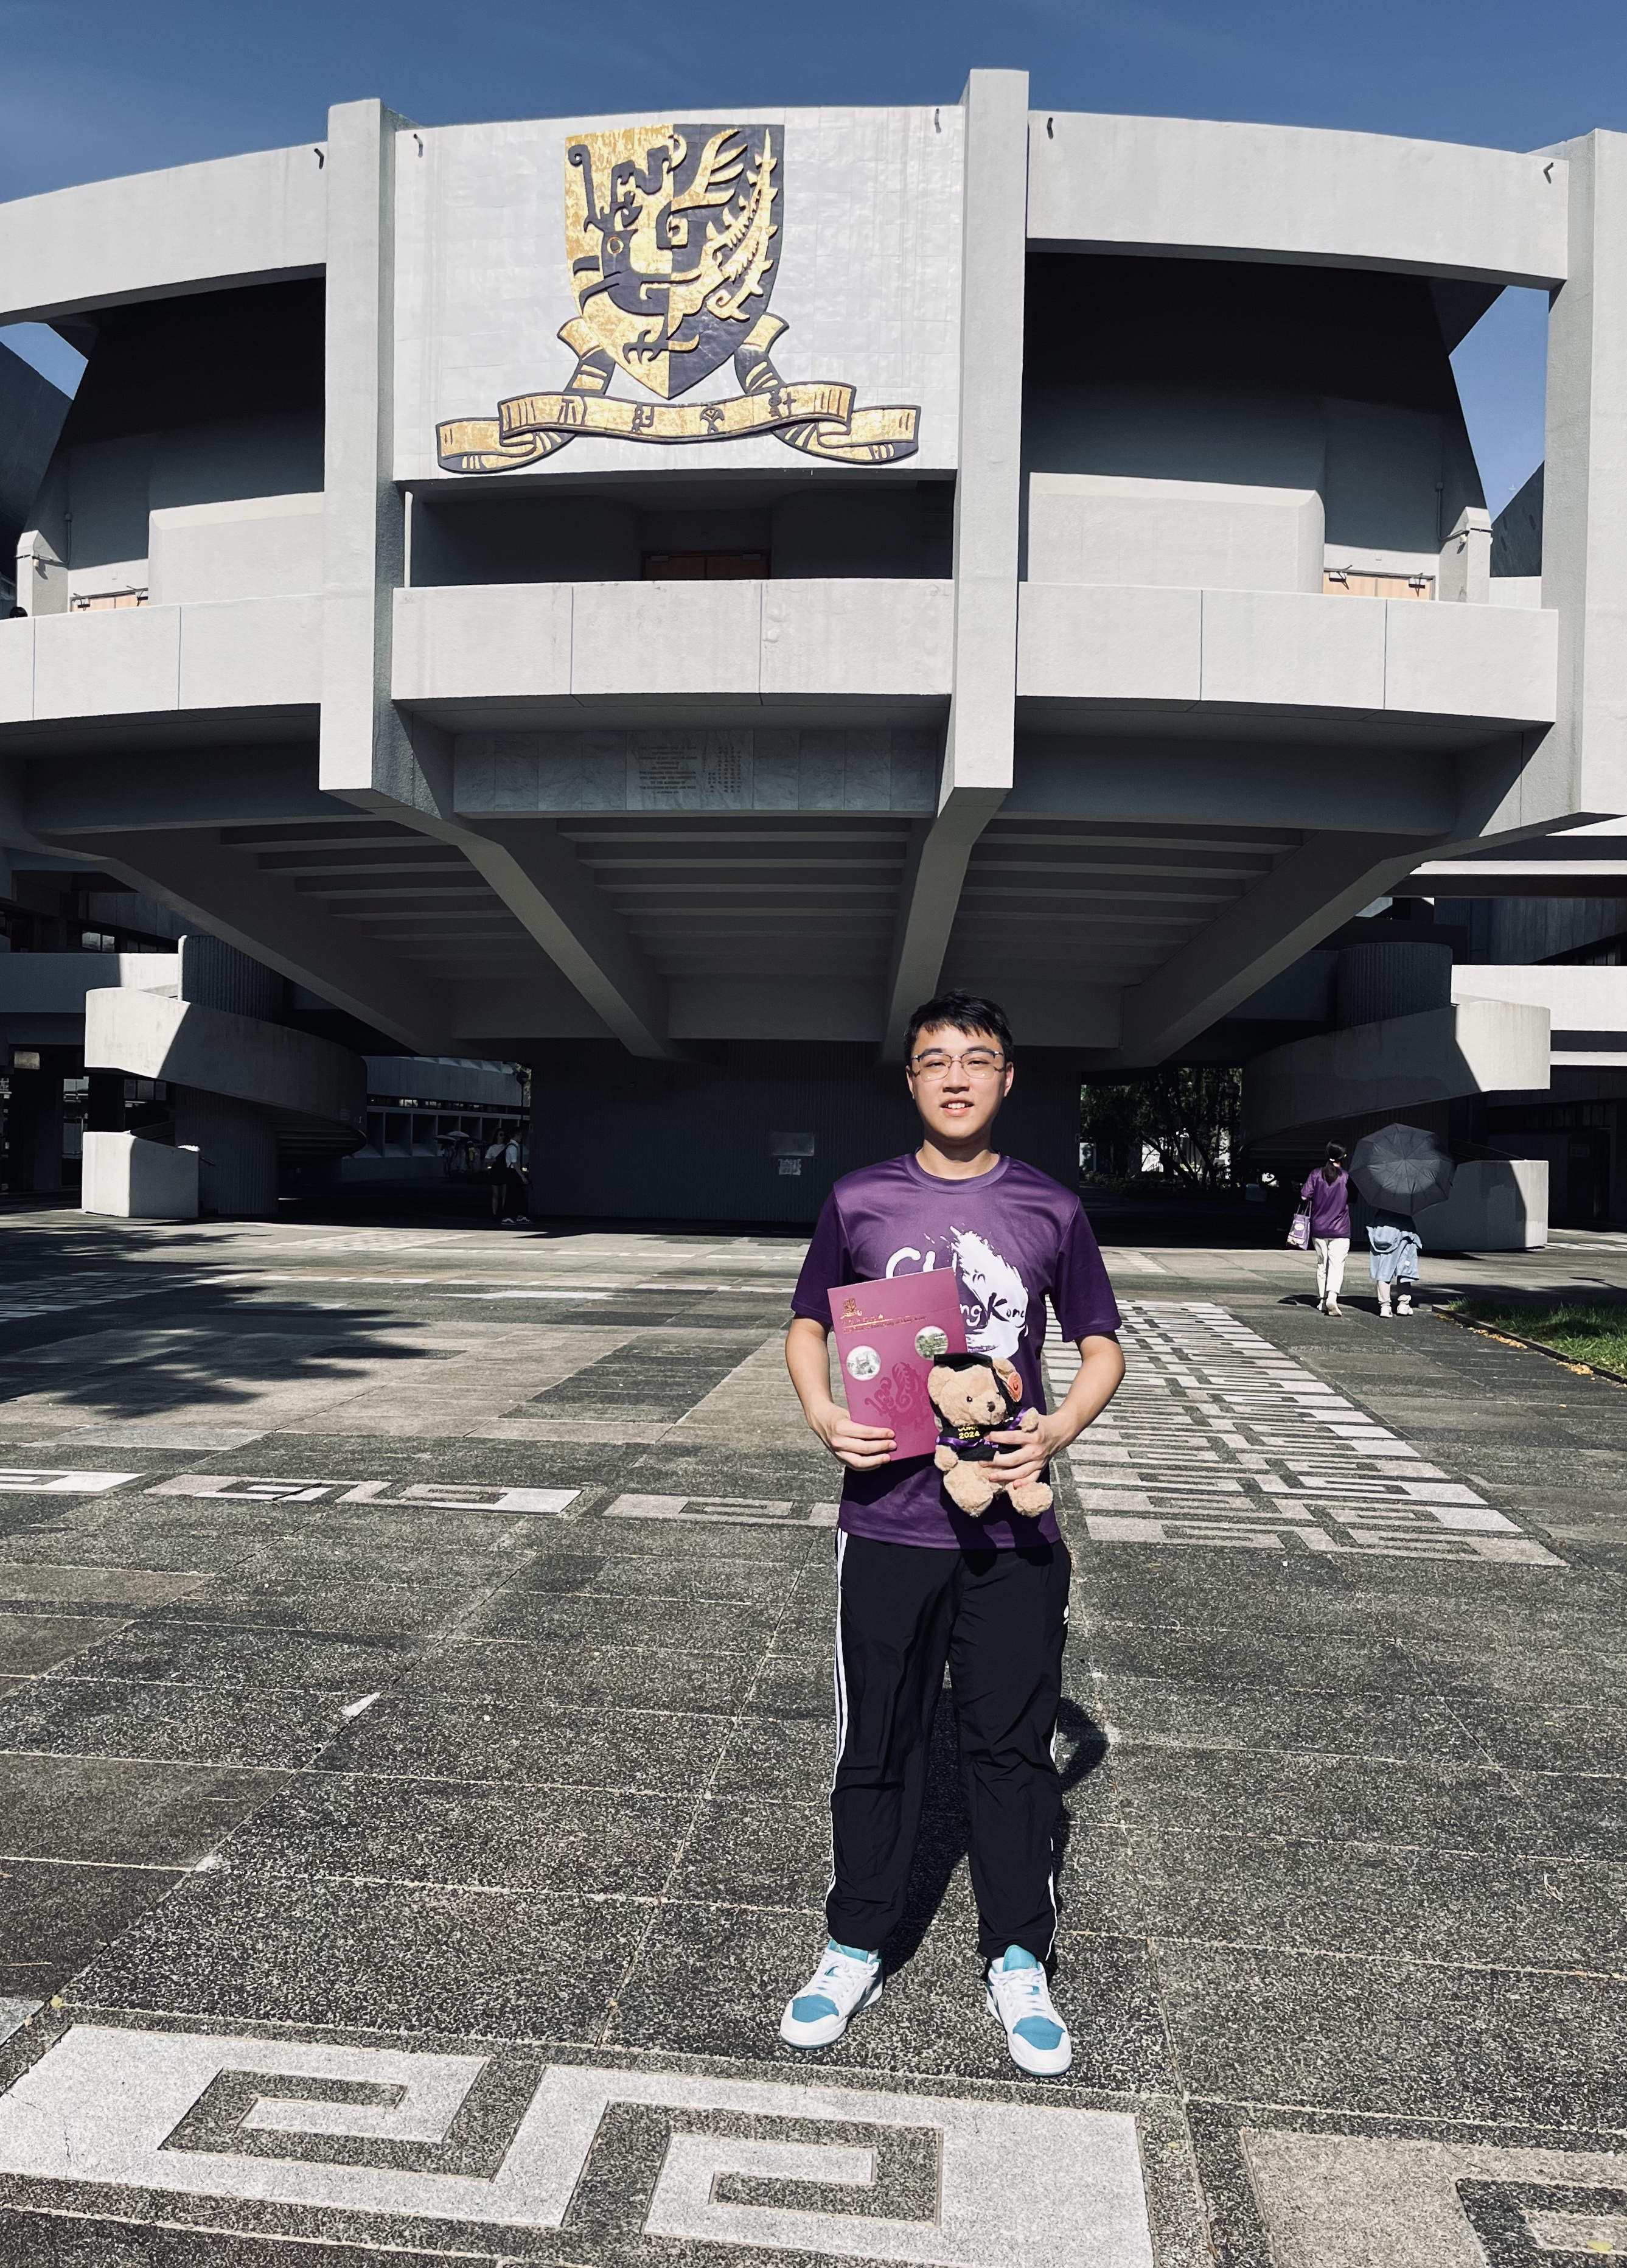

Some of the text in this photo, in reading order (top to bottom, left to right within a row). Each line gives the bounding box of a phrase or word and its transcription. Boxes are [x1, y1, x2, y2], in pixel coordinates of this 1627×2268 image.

[972, 1269, 986, 1283] in
[987, 1292, 1026, 1328] Kong
[958, 1431, 980, 1440] 2024
